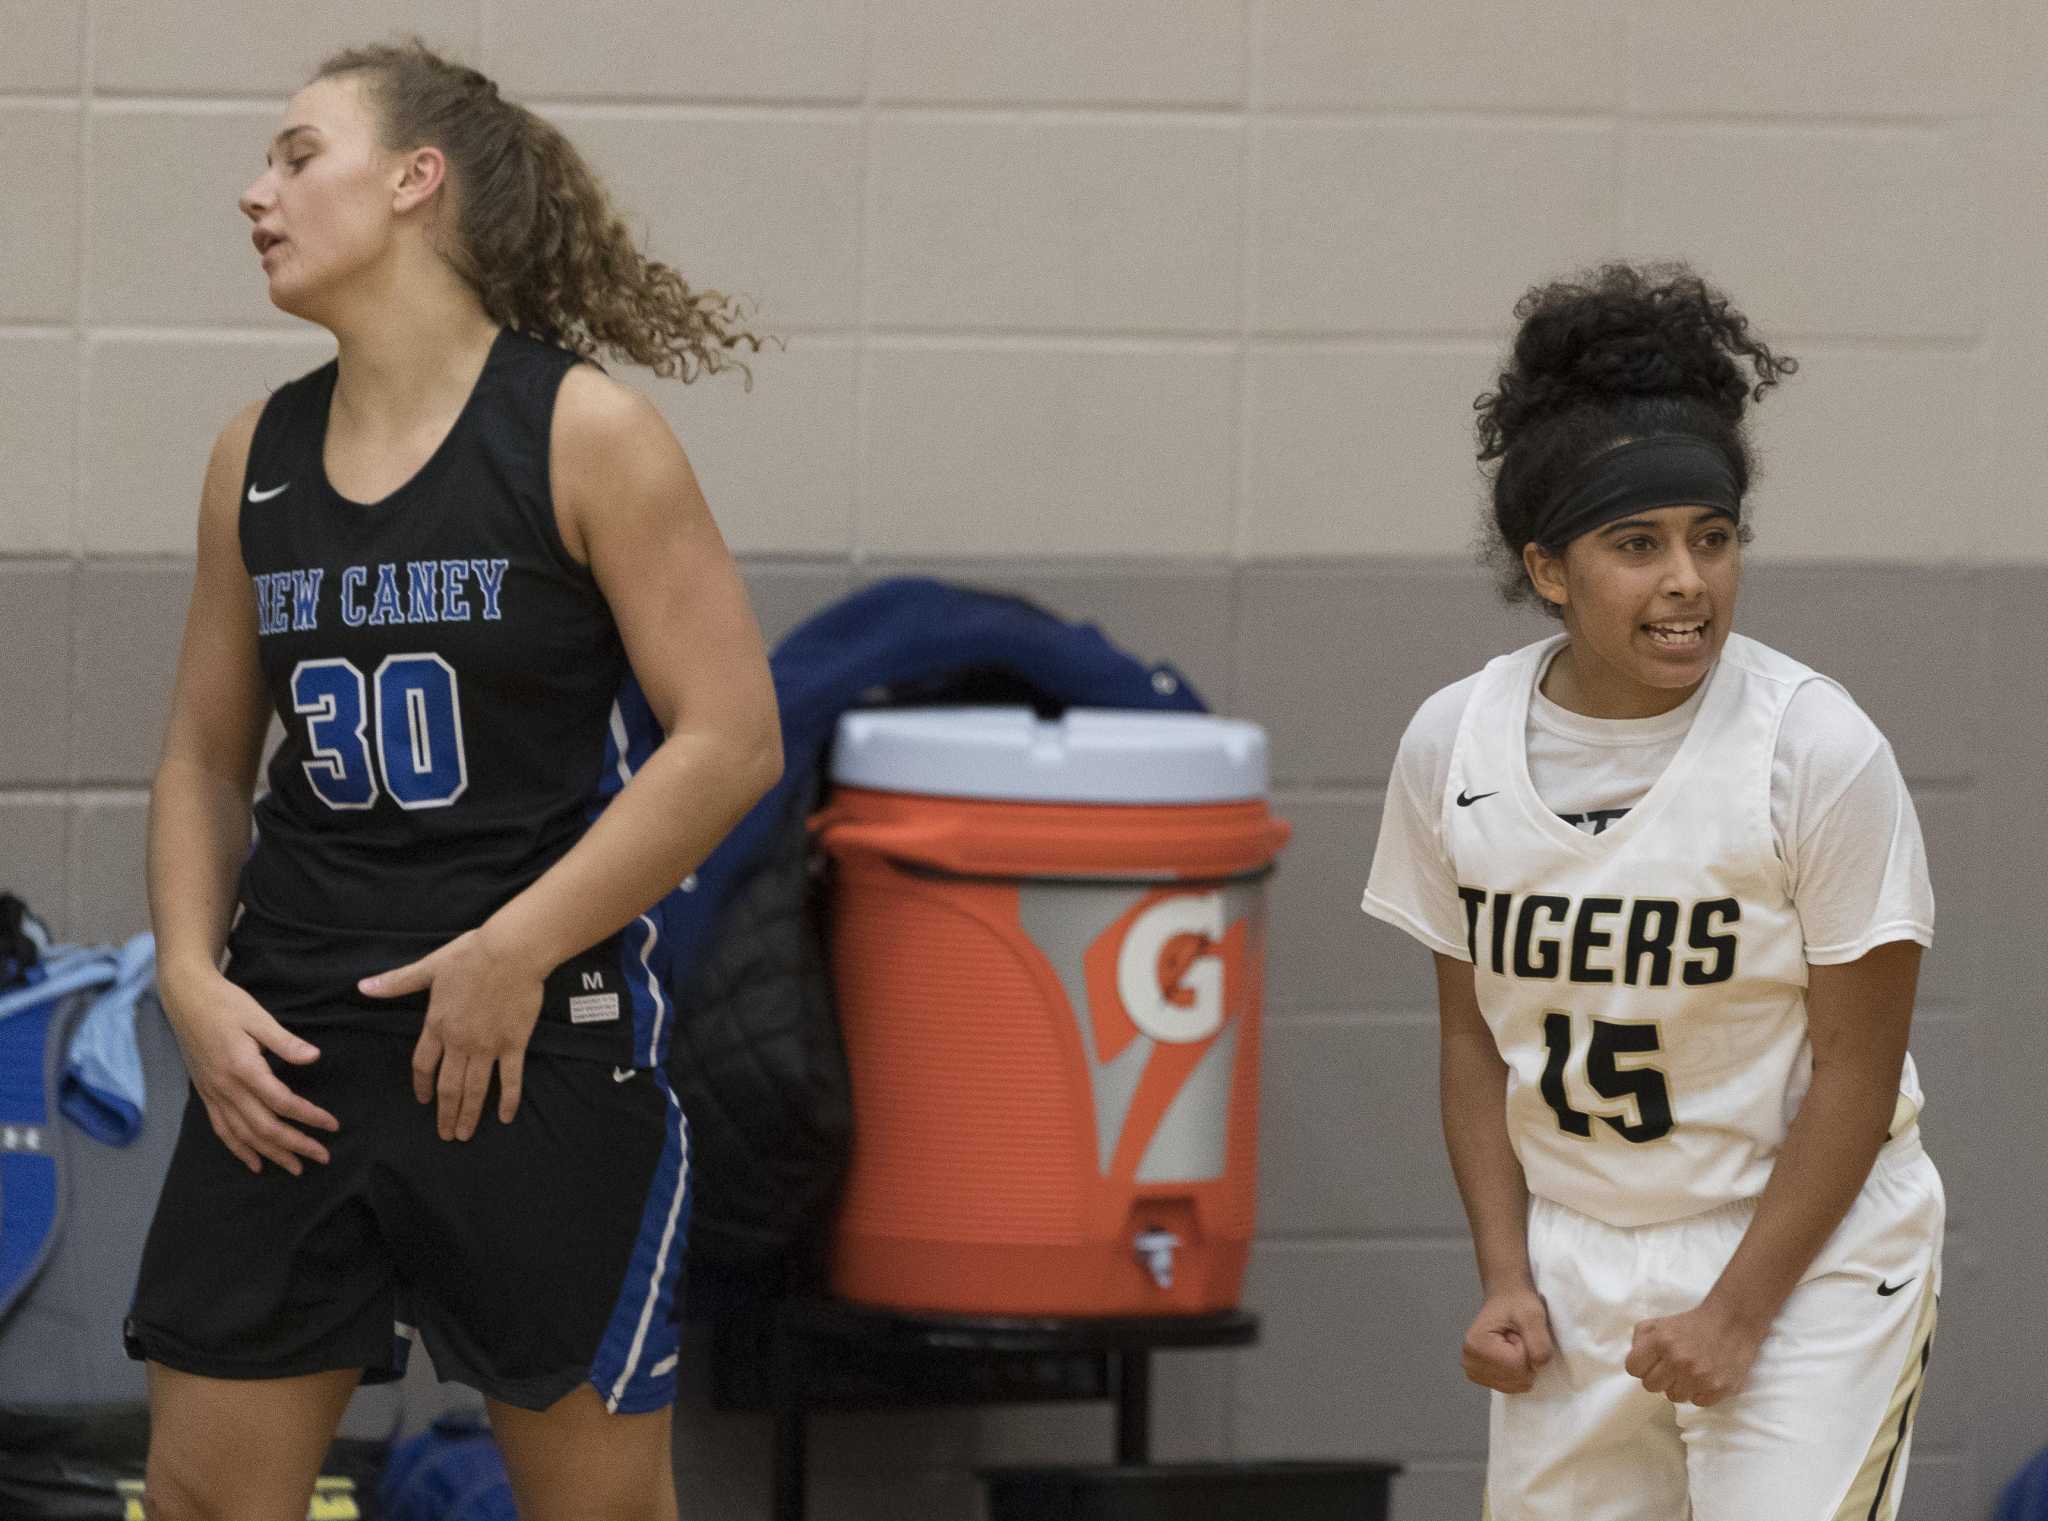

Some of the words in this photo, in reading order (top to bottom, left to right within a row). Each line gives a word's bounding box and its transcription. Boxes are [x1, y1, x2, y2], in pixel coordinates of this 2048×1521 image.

[253, 567, 324, 635] NEW
[340, 558, 509, 627] CANEY
[290, 652, 468, 810] 30
[581, 971, 604, 990] M
[1117, 892, 1224, 1043] G
[1457, 885, 1742, 987] TIGERS
[1539, 1008, 1679, 1144] 15
